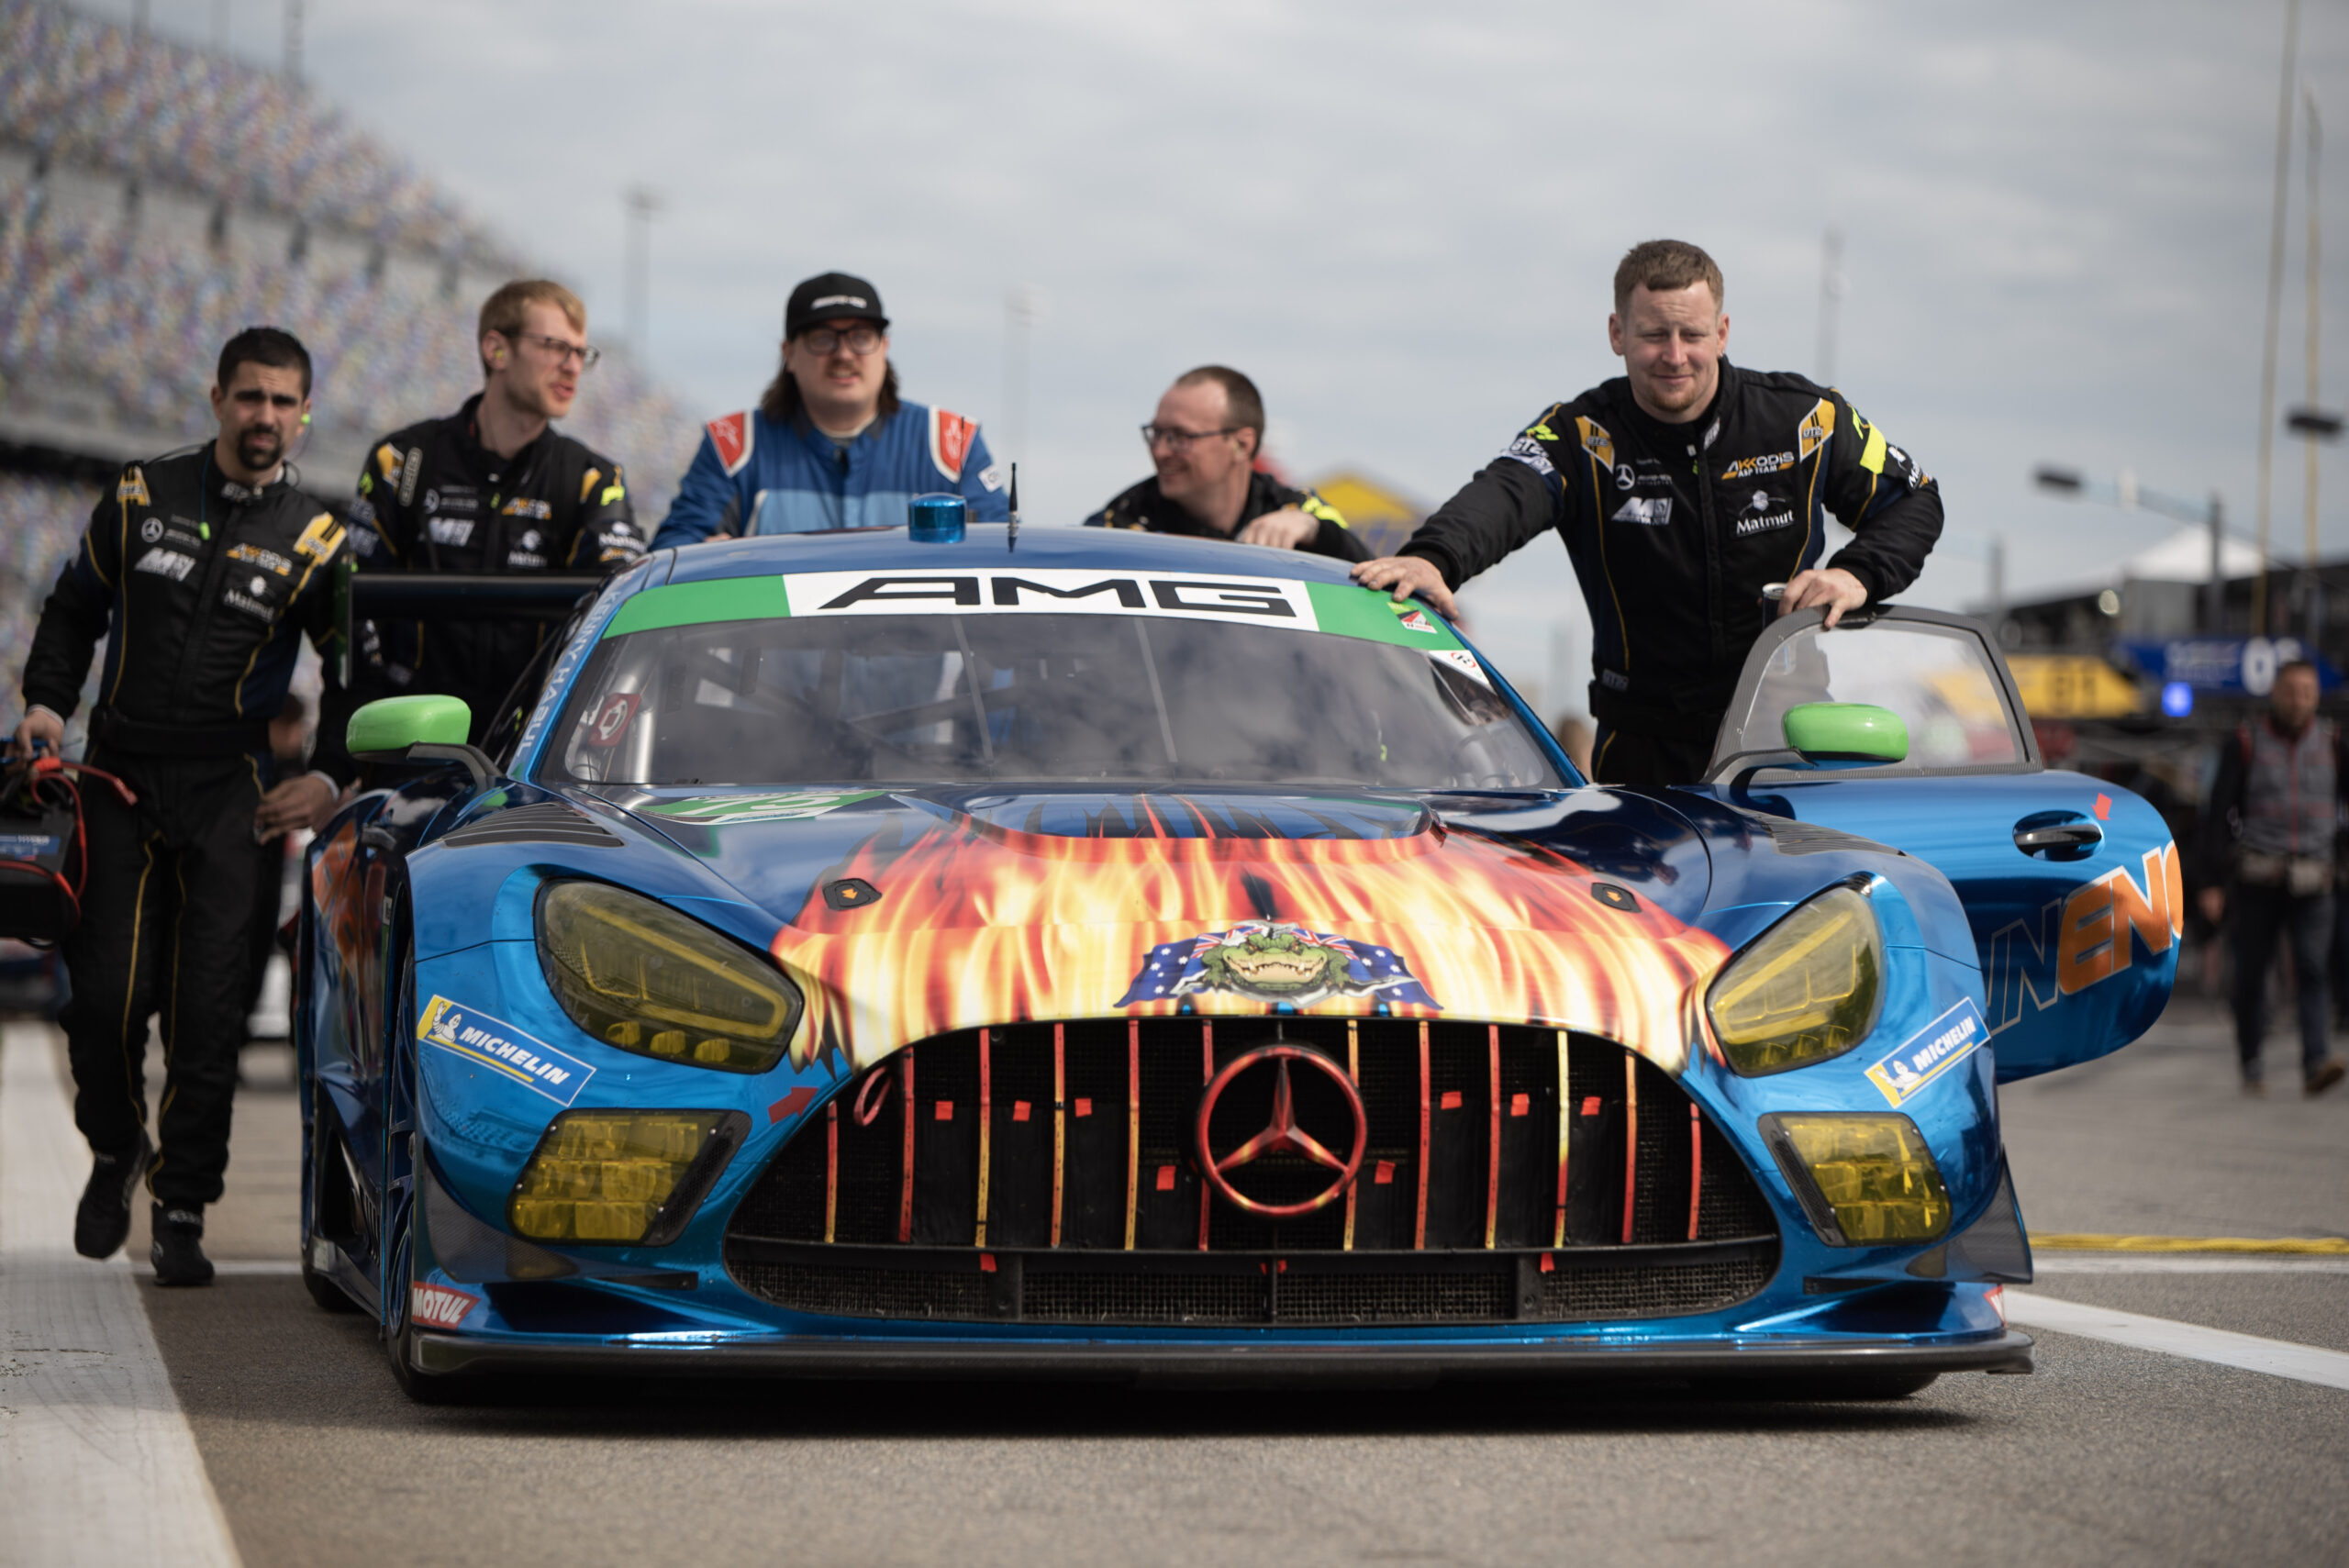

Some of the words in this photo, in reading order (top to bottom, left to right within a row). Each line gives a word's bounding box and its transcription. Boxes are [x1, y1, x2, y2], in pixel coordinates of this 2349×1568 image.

[1727, 451, 1794, 473] AKKODIS
[1755, 465, 1776, 474] TEAM
[1736, 509, 1794, 534] Matmut
[817, 577, 1297, 617] AMG
[568, 591, 622, 662] KENNY
[517, 667, 570, 757] HABUL
[675, 792, 864, 816] 75
[459, 1027, 571, 1084] MICHELIN
[1912, 1016, 1976, 1072] MICHELIN
[413, 1287, 471, 1323] MOTUL
